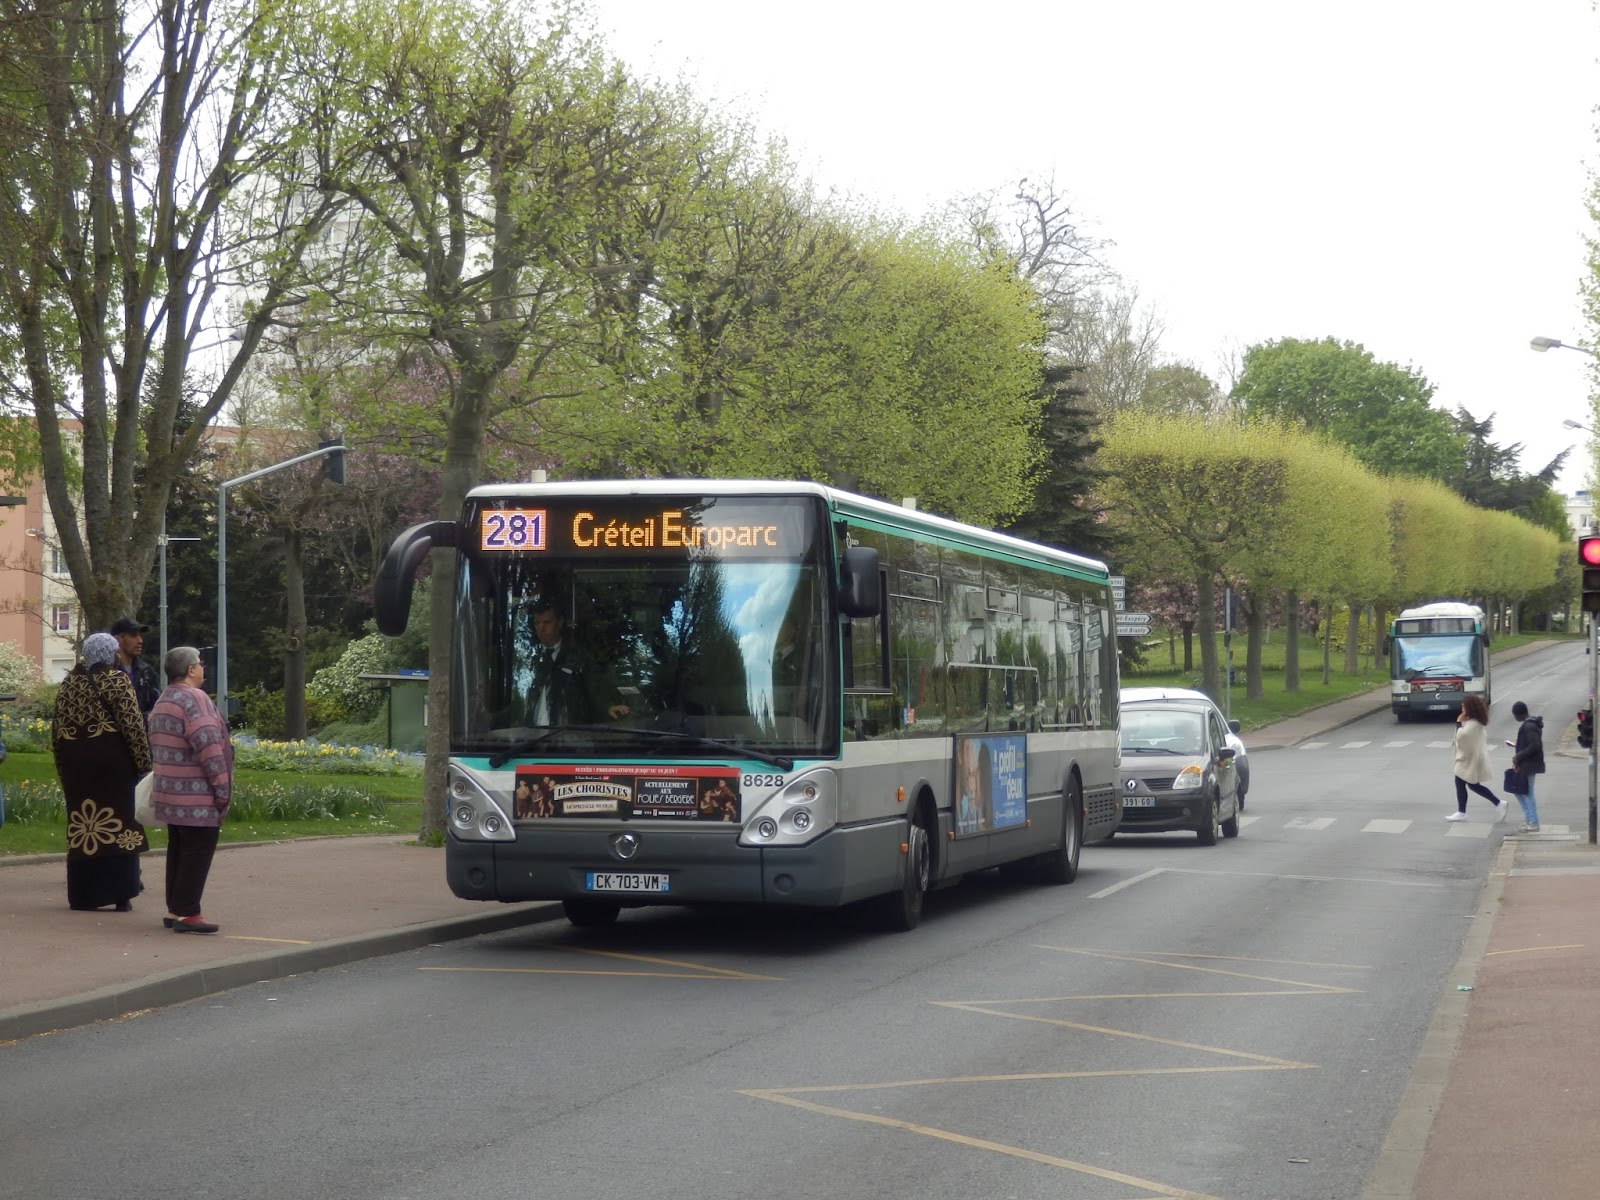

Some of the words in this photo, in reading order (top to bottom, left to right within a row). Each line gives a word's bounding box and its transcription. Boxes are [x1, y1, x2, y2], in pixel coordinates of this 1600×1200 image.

[486, 514, 542, 546] 281
[572, 512, 654, 547] Créteil
[662, 511, 777, 549] Europarc
[743, 774, 784, 787] 8628
[557, 786, 573, 797] LES
[576, 784, 628, 798] CHORISTES
[637, 794, 664, 804] FOLIES
[596, 874, 659, 890] CK-703-VM
